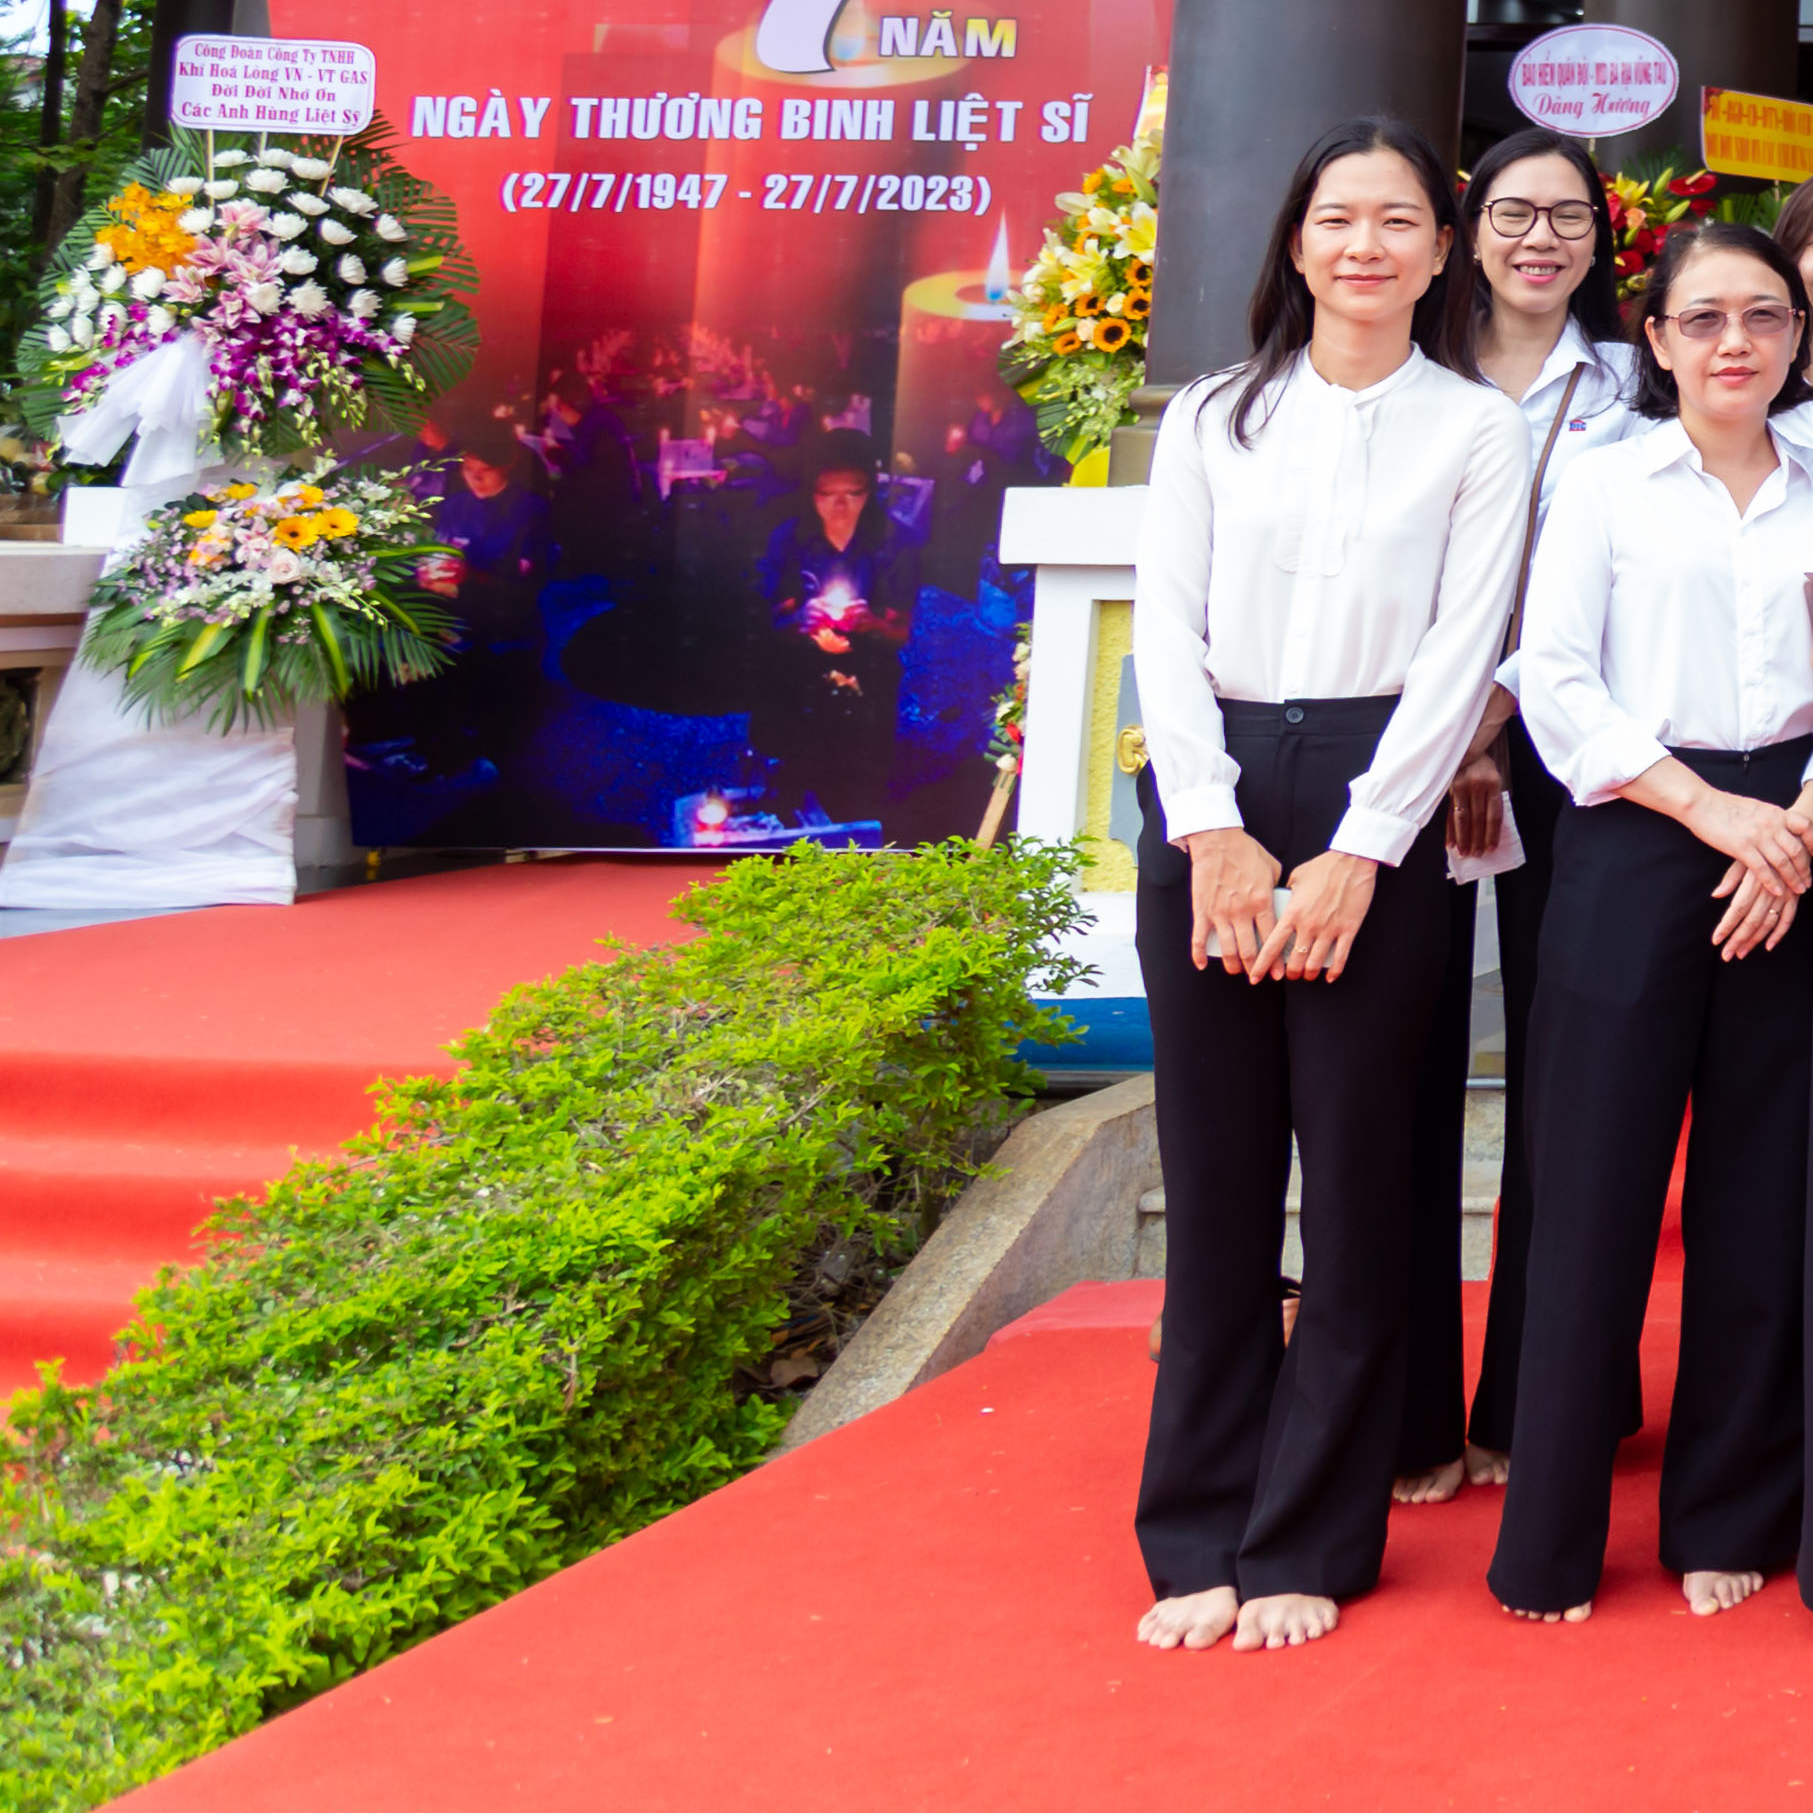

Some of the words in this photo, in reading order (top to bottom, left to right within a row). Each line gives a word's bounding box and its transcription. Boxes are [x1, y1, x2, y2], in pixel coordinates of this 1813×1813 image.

[879, 10, 1019, 59] NĂM
[194, 43, 227, 60] Công
[303, 48, 317, 66] Ty
[321, 49, 355, 65] TNHH
[285, 67, 305, 83] VN
[318, 68, 336, 84] VT
[340, 68, 368, 85] GAS
[219, 103, 249, 120] Anh
[411, 87, 552, 142] NGÀY
[571, 92, 765, 142] THƯƠNG
[780, 97, 896, 142] BINH
[913, 93, 1027, 152] LIỆT
[1041, 93, 1095, 144] SĨ
[503, 172, 729, 214] (27/7/1947
[764, 174, 994, 216] 27/7/2023)
